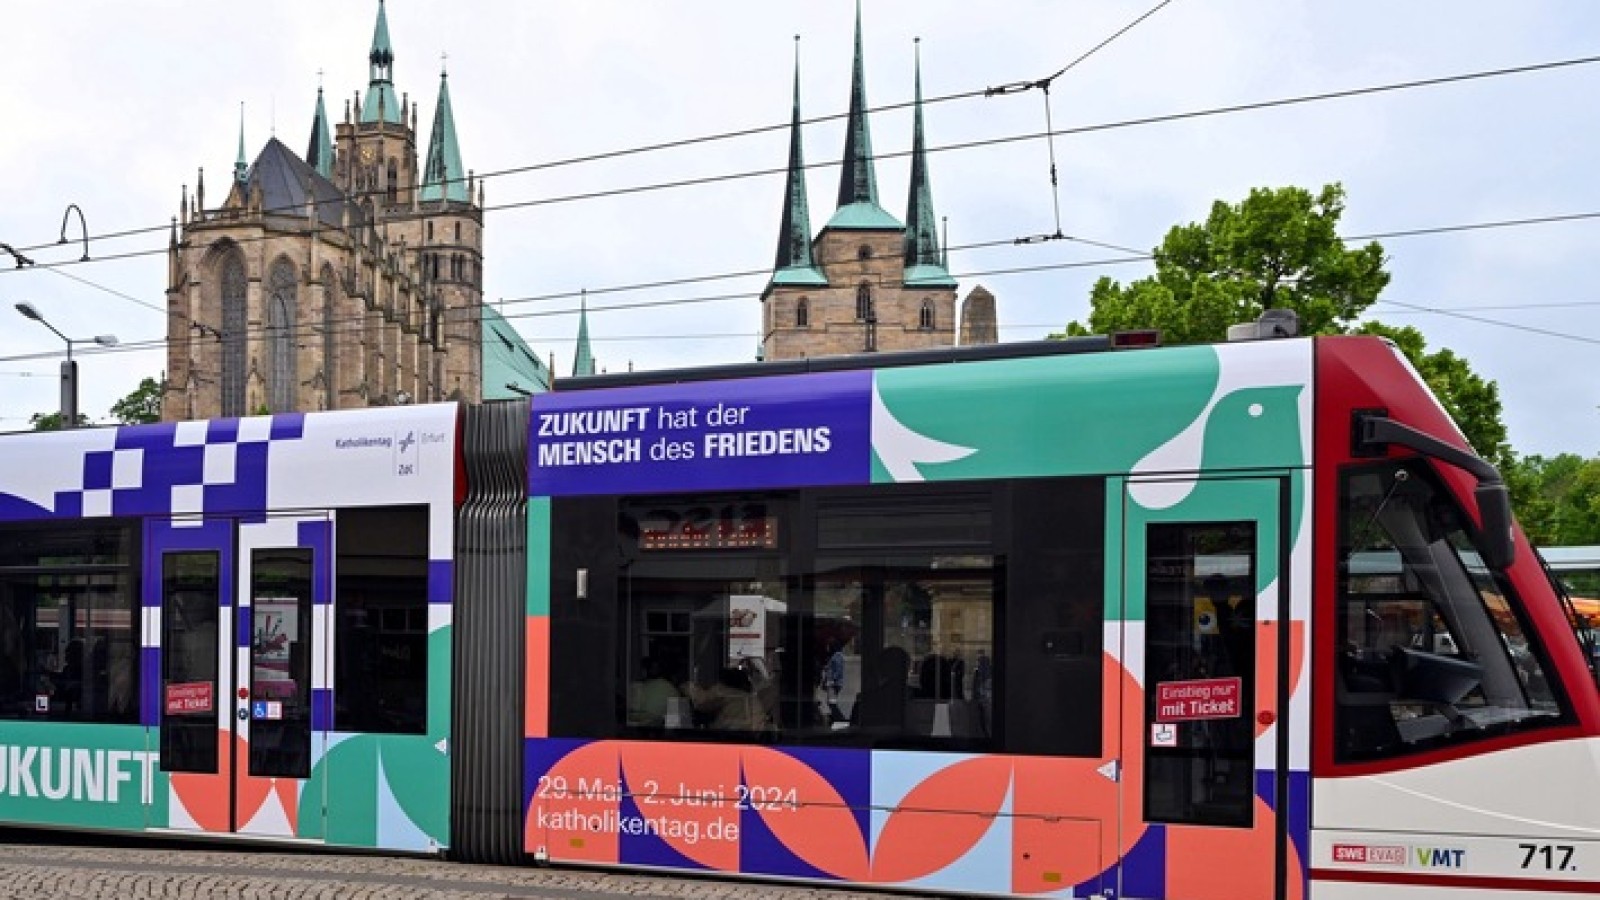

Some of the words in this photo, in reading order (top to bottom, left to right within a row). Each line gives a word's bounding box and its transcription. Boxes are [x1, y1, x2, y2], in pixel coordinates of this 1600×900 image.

[538, 408, 651, 436] ZUKUNFT
[657, 405, 698, 430] hat
[706, 402, 750, 427] der
[538, 438, 641, 467] MENSCH
[649, 436, 695, 461] des
[704, 426, 831, 458] FRIEDENS
[1162, 686, 1211, 700] Einstieg
[1211, 685, 1236, 696] nur
[1162, 701, 1186, 716] mit
[1189, 698, 1235, 715] Ticket
[0, 744, 160, 805] KUNFT
[538, 775, 573, 800] 29.
[578, 777, 622, 802] Mai
[643, 780, 666, 804] 2.
[671, 782, 724, 809] Juni
[733, 784, 797, 812] 2024
[537, 804, 739, 845] katholikentag.de
[1335, 847, 1365, 859] SWE
[1416, 847, 1466, 868] VMT
